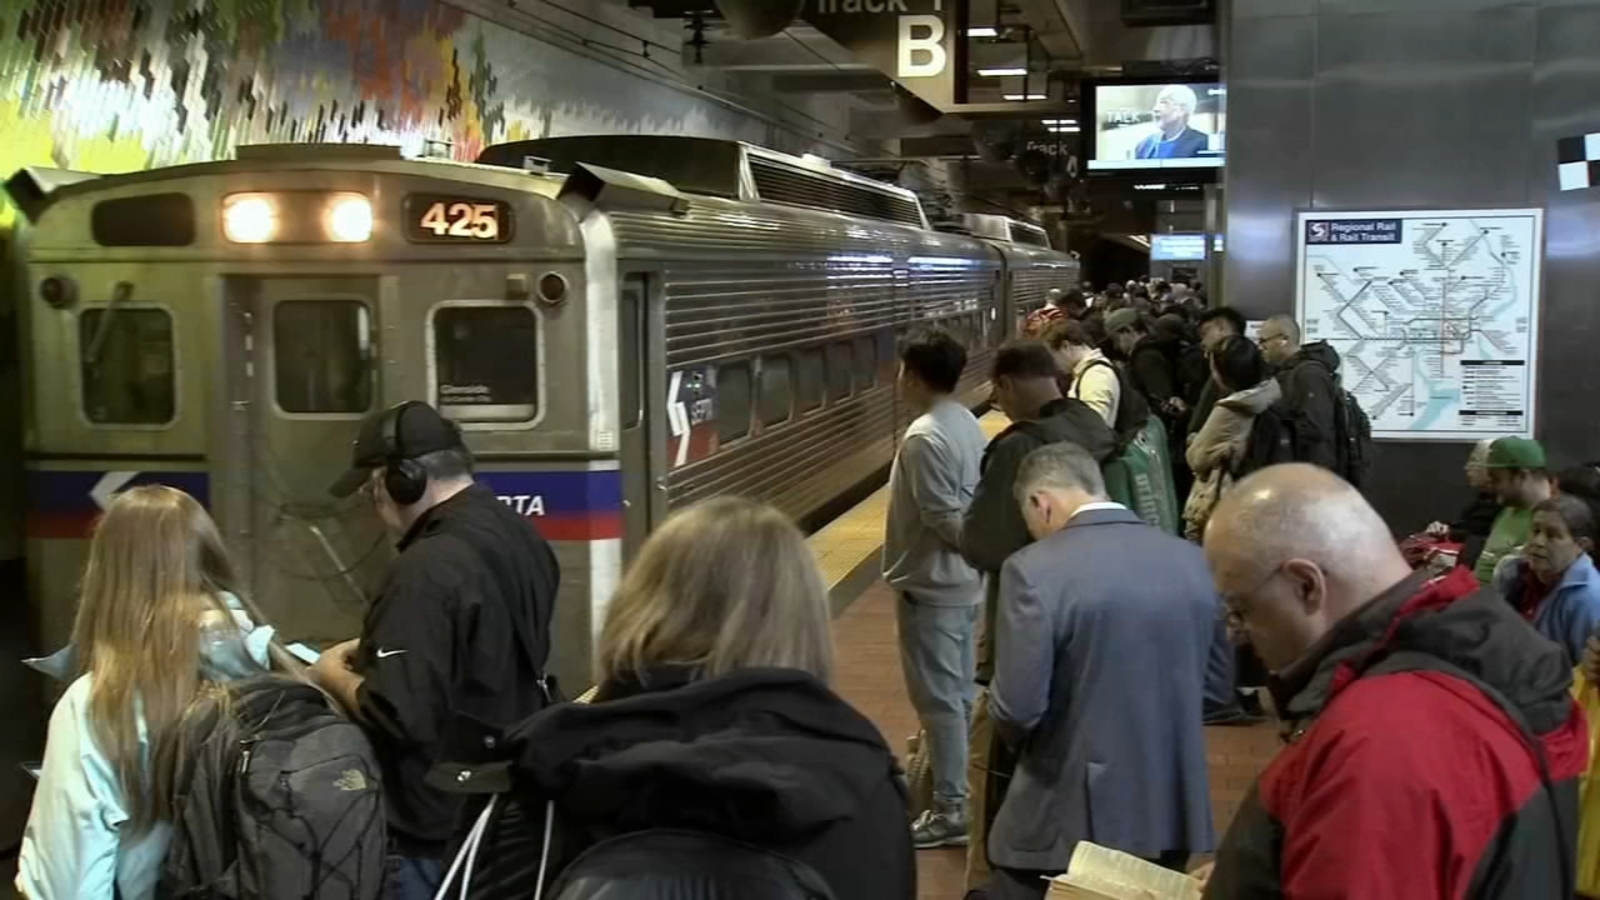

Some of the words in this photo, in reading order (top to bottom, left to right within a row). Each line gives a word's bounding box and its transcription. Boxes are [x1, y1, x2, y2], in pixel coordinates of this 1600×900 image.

[898, 15, 945, 77] B
[420, 202, 498, 239] 425
[1331, 222, 1375, 233] Regional
[1376, 222, 1396, 231] Rail
[1331, 233, 1337, 241] &
[1339, 232, 1360, 241] Rail
[1360, 232, 1396, 241] Transit
